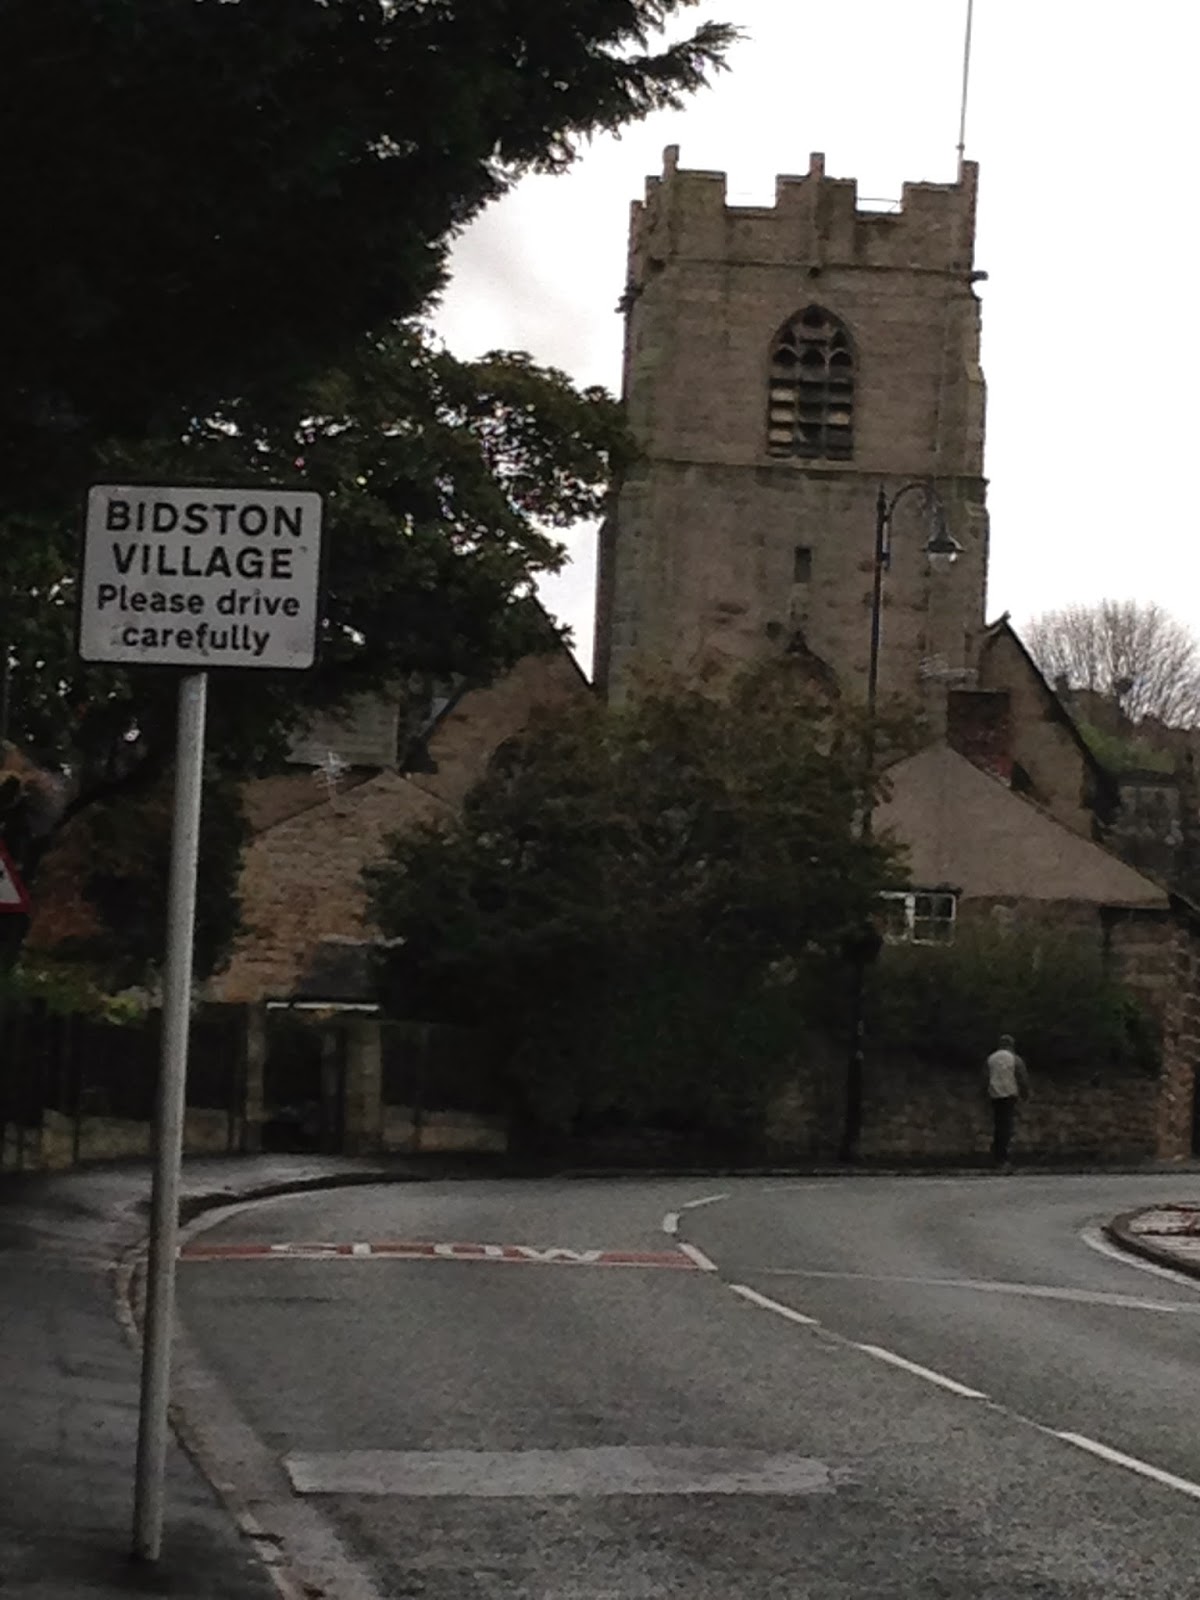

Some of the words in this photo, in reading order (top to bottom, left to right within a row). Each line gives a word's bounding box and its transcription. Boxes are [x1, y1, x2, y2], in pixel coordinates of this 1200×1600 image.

[106, 501, 302, 537] BIDSTON
[112, 542, 293, 579] VILLAGE
[98, 583, 204, 615] Please
[216, 589, 300, 616] drive
[122, 624, 270, 656] carefully
